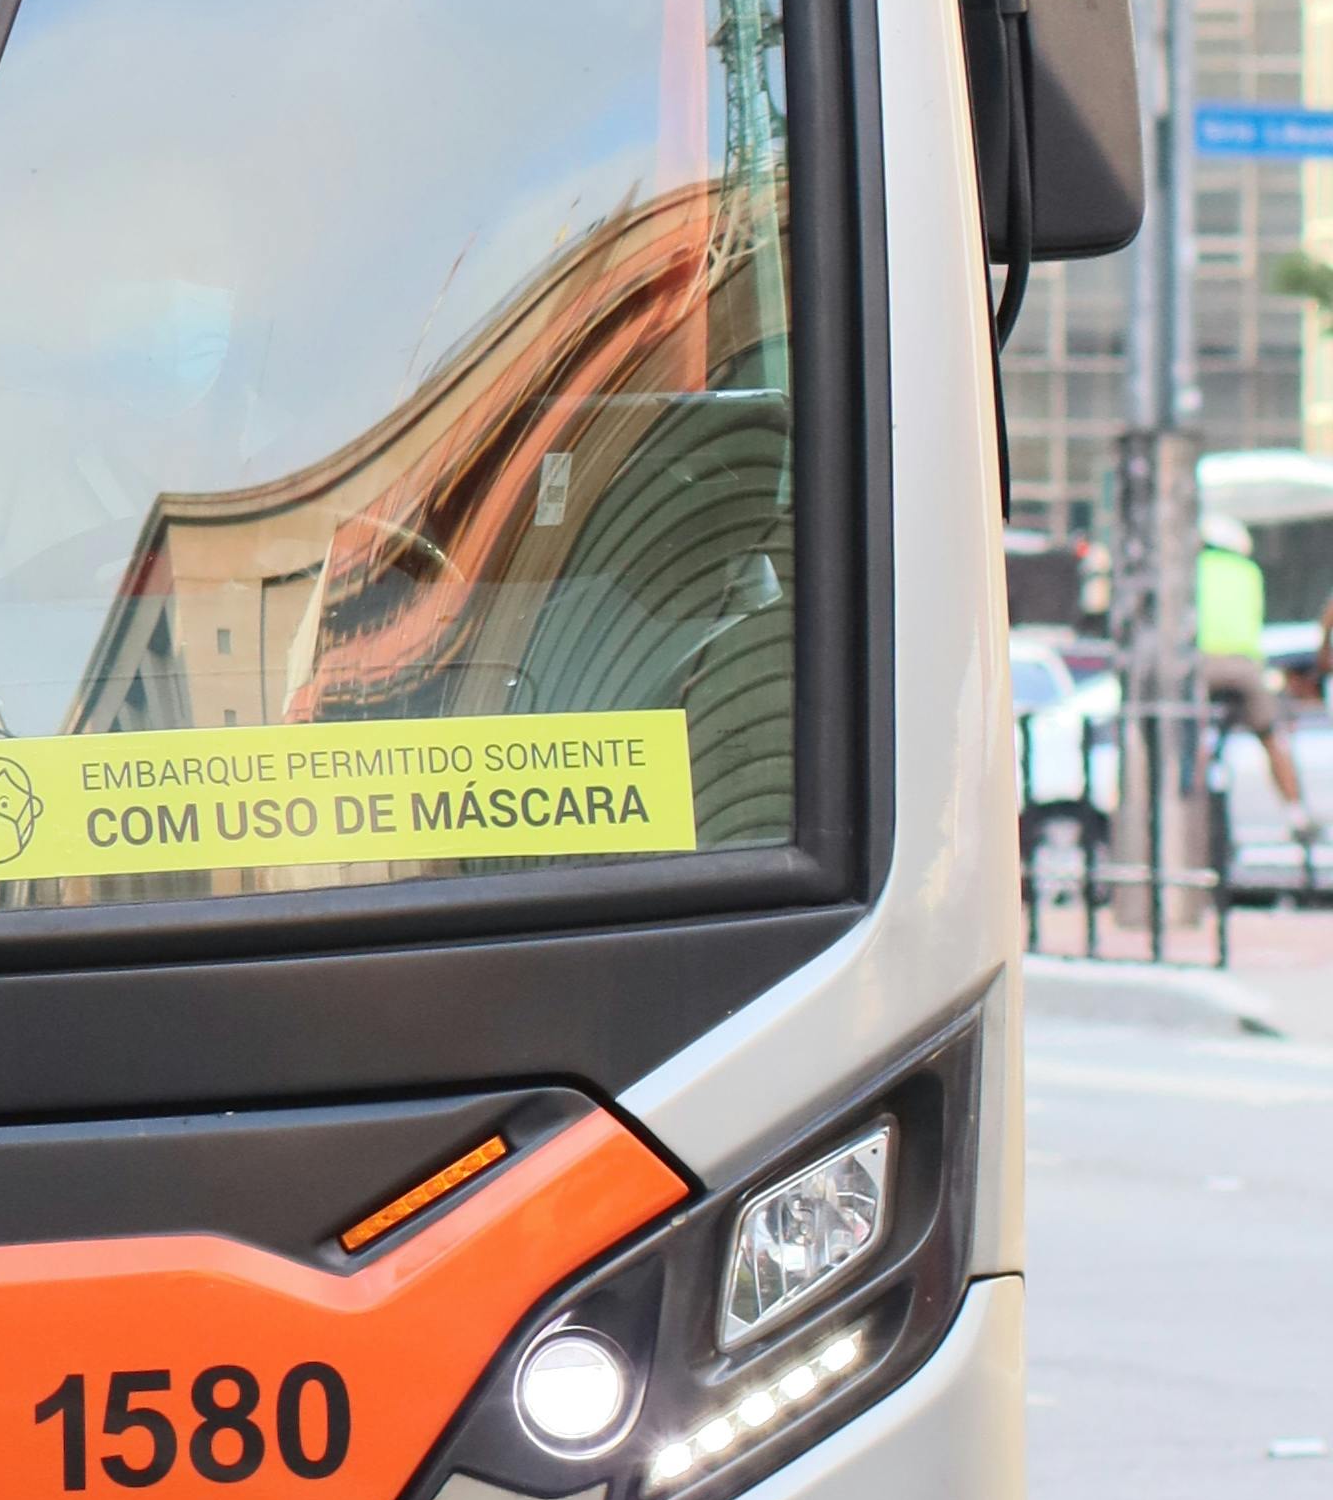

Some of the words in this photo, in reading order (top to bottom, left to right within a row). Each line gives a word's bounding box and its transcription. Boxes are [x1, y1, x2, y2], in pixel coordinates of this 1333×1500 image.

[81, 753, 277, 791] EMBARQUE
[287, 744, 474, 781] PERMITIDO
[484, 738, 647, 773] SOMENTE
[86, 802, 200, 848] COM
[215, 796, 319, 841] USO
[334, 793, 397, 835] DE
[411, 780, 650, 832] MÁSCARA
[34, 1360, 352, 1492] 1580
